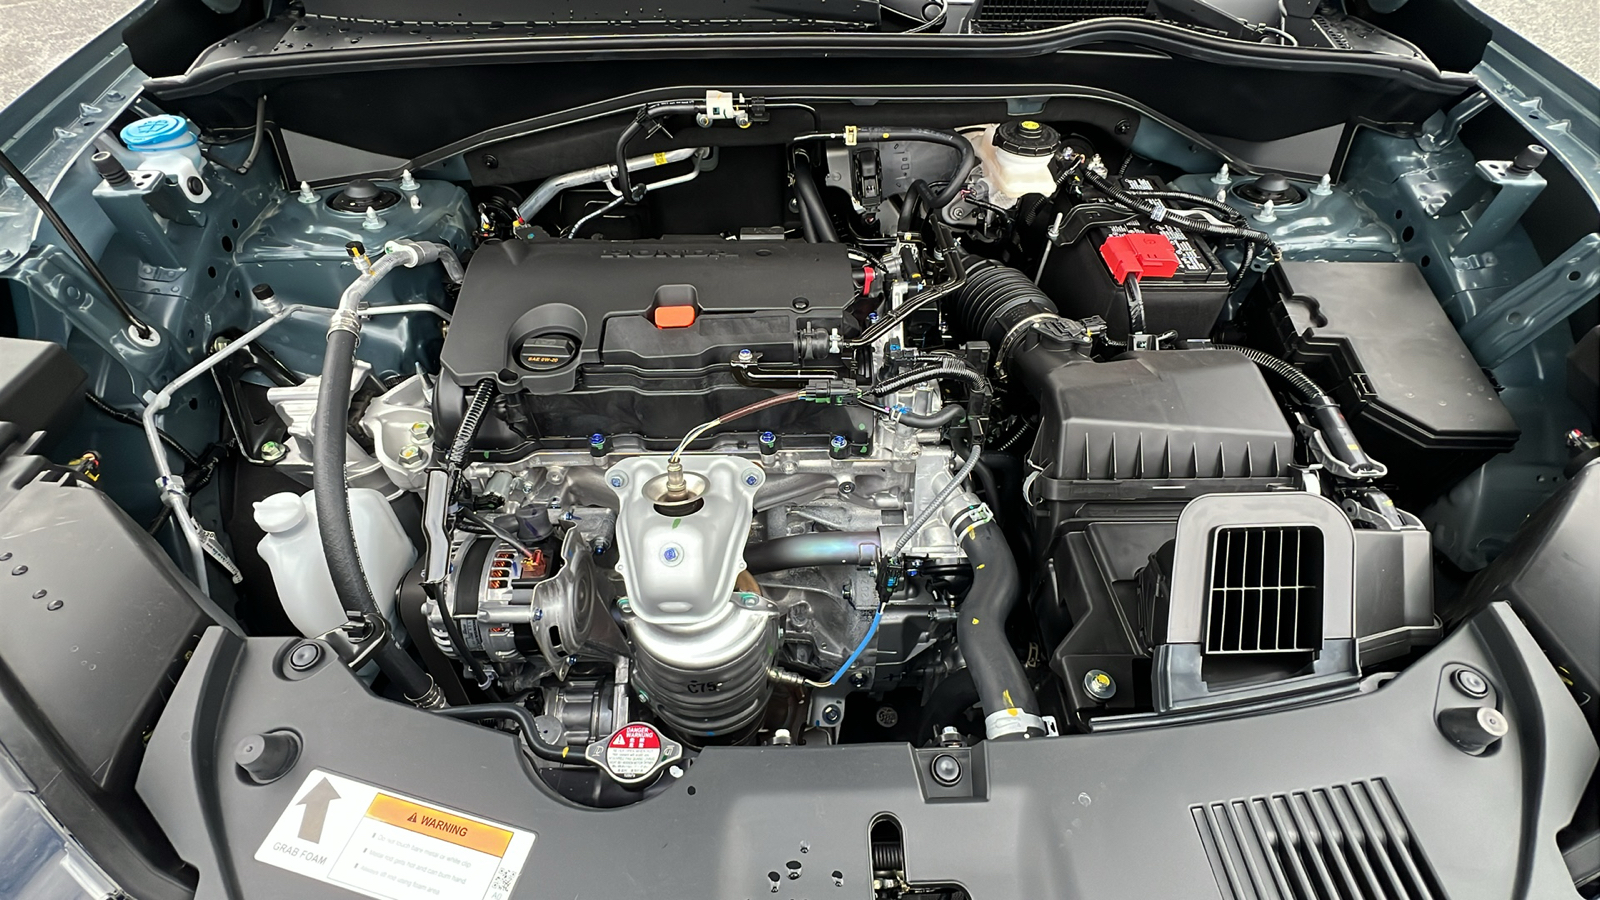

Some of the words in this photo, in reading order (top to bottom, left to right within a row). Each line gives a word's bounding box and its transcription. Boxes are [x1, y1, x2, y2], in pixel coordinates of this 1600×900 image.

[420, 814, 468, 838] WARNING
[272, 842, 300, 857] GRAB
[300, 850, 328, 866] FOAM
[446, 856, 461, 865] white
[415, 864, 428, 872] and
